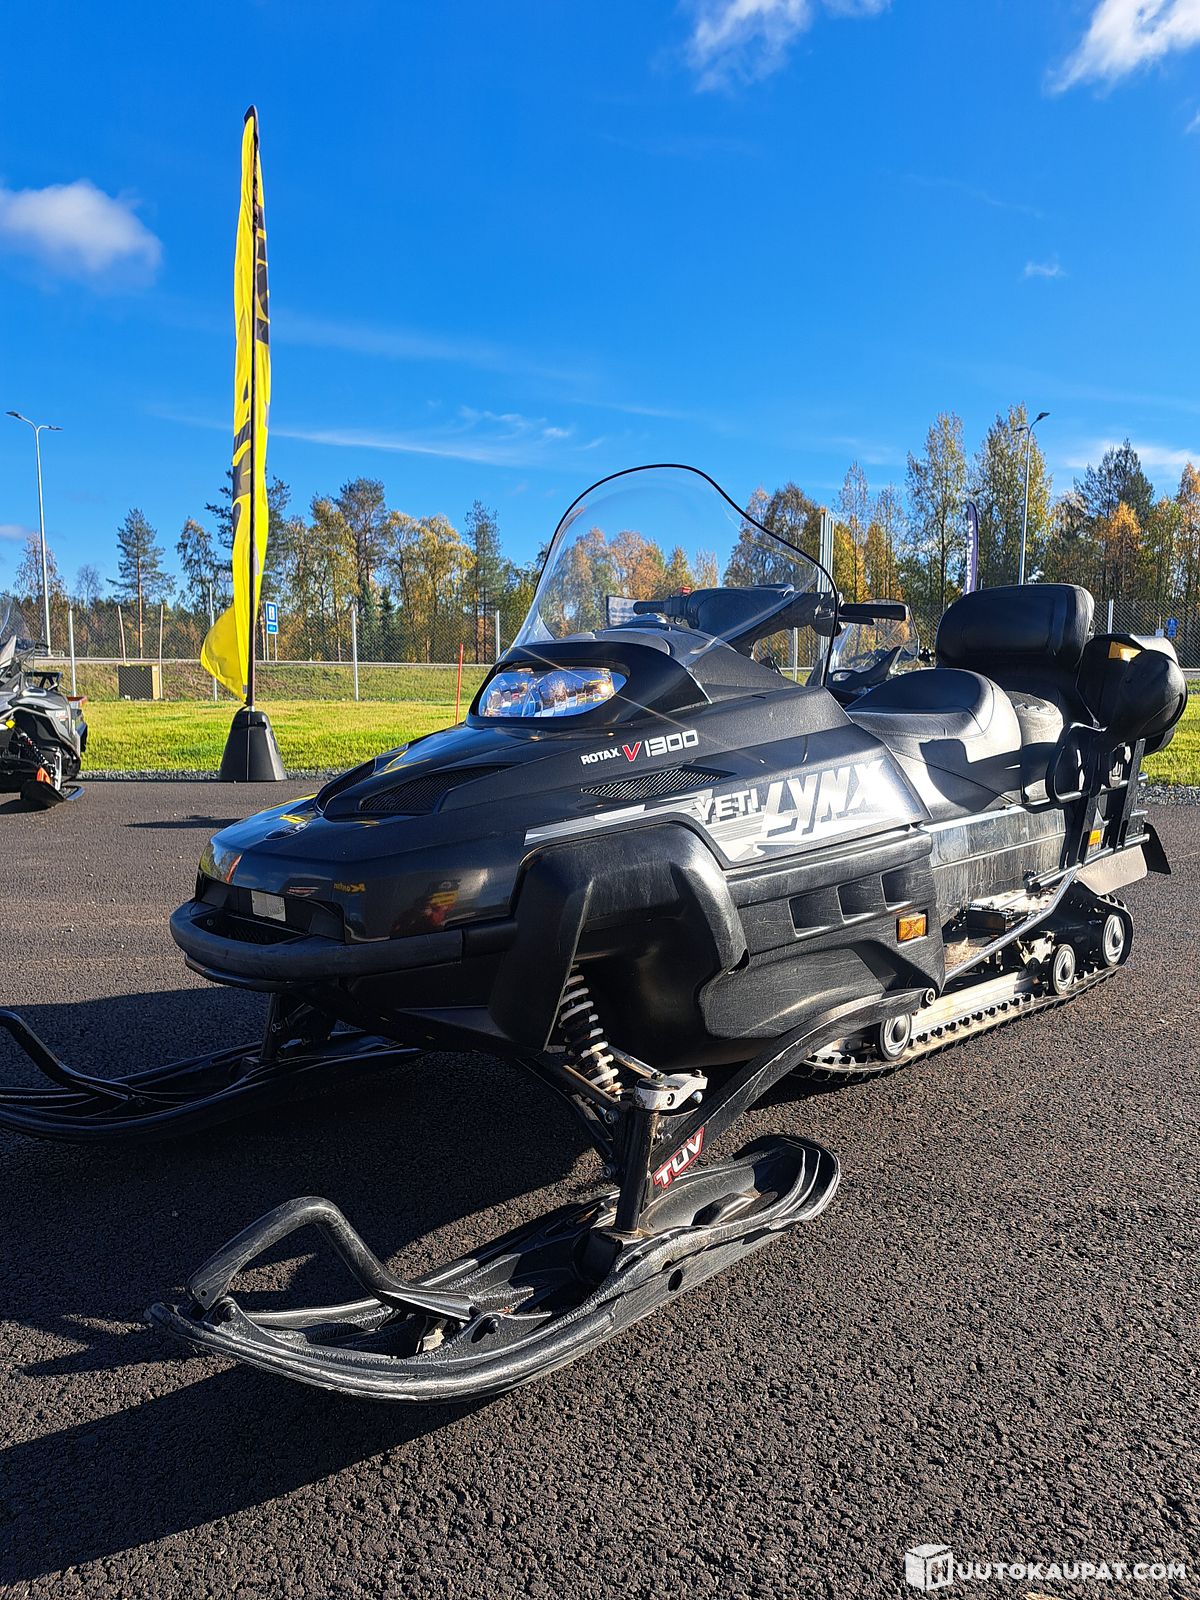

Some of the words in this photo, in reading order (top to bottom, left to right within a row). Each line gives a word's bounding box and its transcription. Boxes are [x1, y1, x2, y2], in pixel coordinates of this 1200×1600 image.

[580, 747, 621, 765] ROTAX
[694, 788, 760, 822] YETI
[763, 758, 890, 836] LYNX
[655, 1132, 702, 1185] TUV
